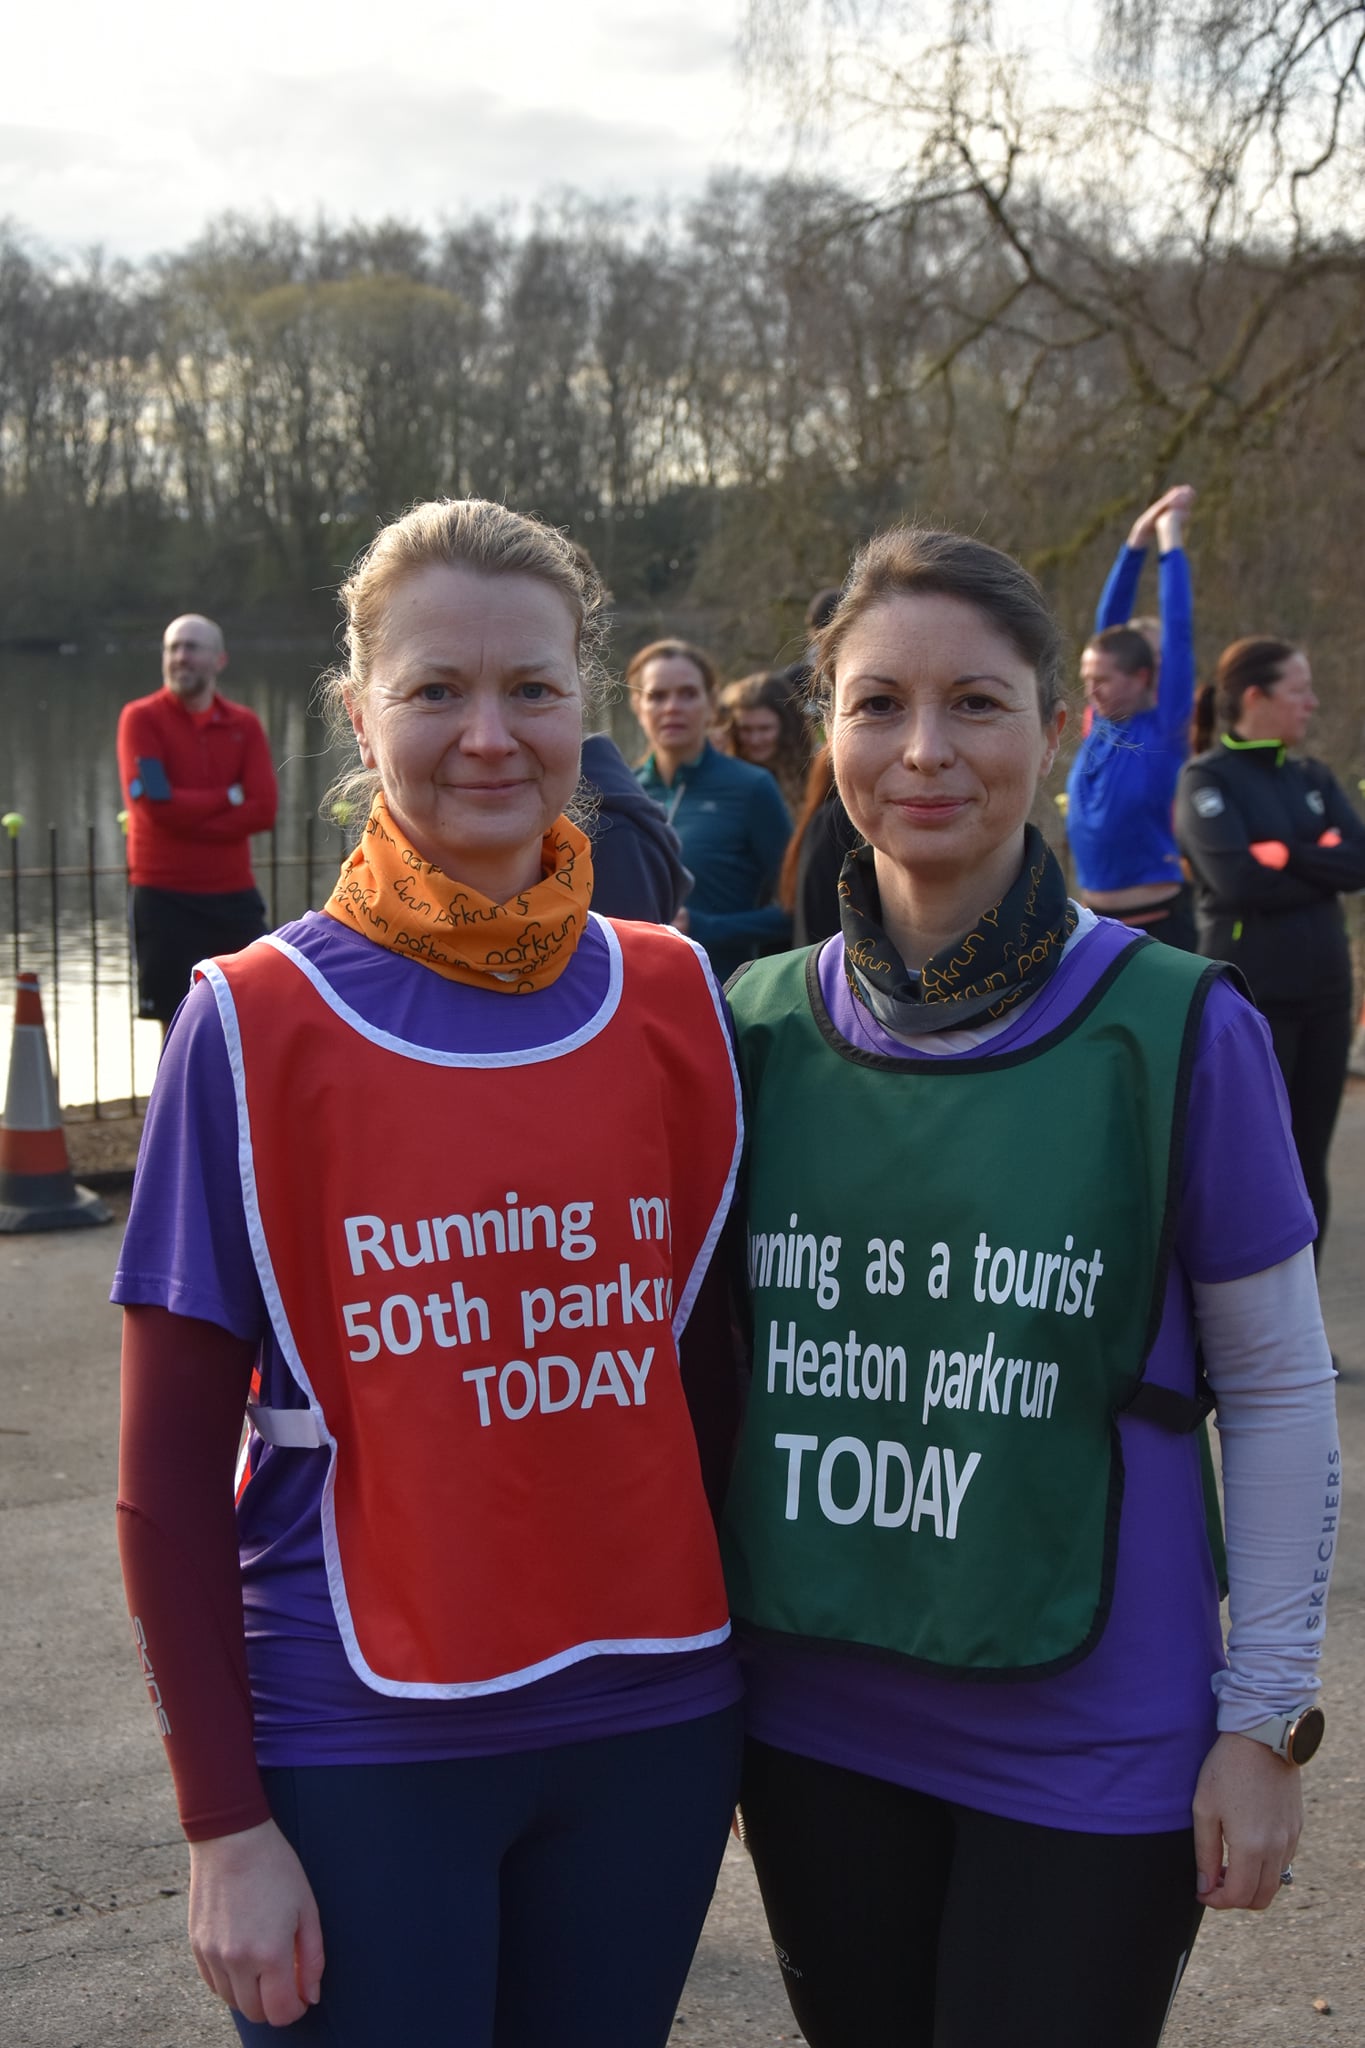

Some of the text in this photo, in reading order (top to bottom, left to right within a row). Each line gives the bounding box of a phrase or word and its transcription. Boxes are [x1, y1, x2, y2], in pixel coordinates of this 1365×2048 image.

[433, 893, 508, 927] parkrun
[344, 1191, 672, 1276] Running m
[865, 1238, 905, 1296] as
[927, 1242, 950, 1299] a
[973, 1232, 1104, 1318] tourist
[343, 1281, 491, 1362] 50th
[462, 1347, 655, 1427] TODAY
[767, 1320, 1059, 1425] Heaton parkrun
[774, 1433, 982, 1540] TODAY
[1306, 1449, 1340, 1630] SKECHERS
